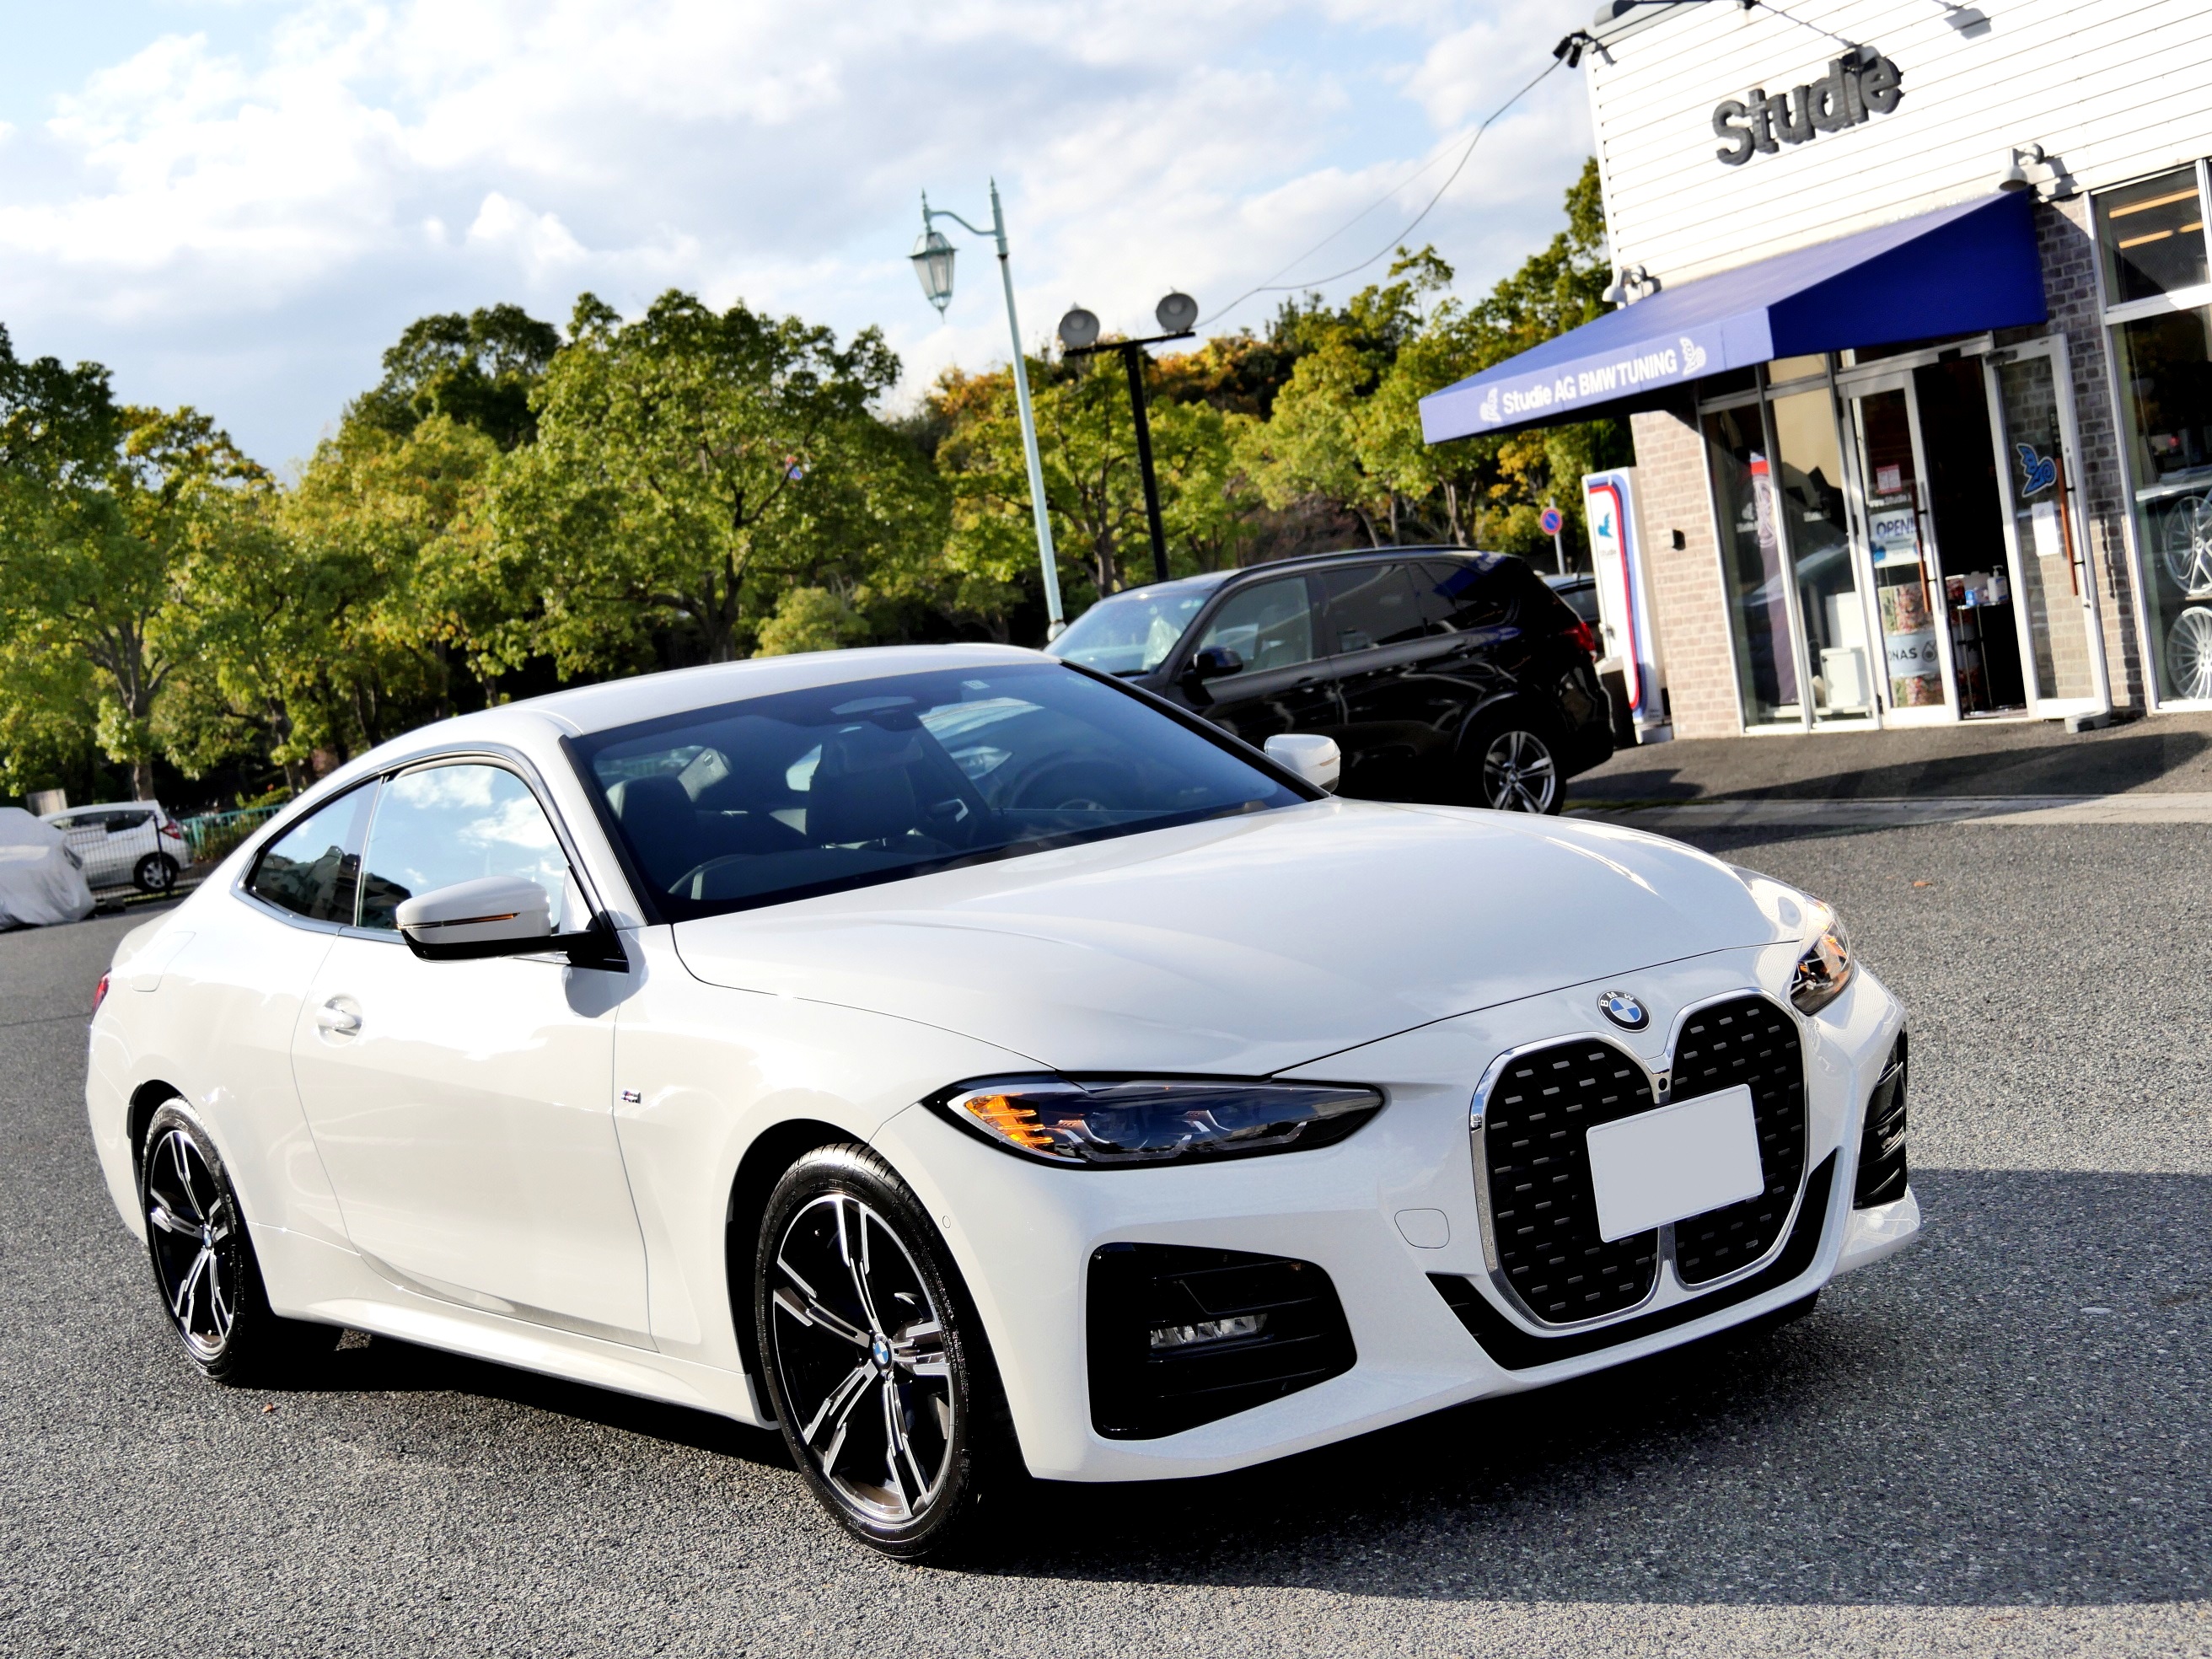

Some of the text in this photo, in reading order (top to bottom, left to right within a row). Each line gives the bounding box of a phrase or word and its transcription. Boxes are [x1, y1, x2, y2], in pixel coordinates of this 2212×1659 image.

[1712, 51, 1904, 166] Studie
[1502, 349, 1678, 415] Studie AG BMW TUNING
[1600, 991, 1635, 1007] BMW
